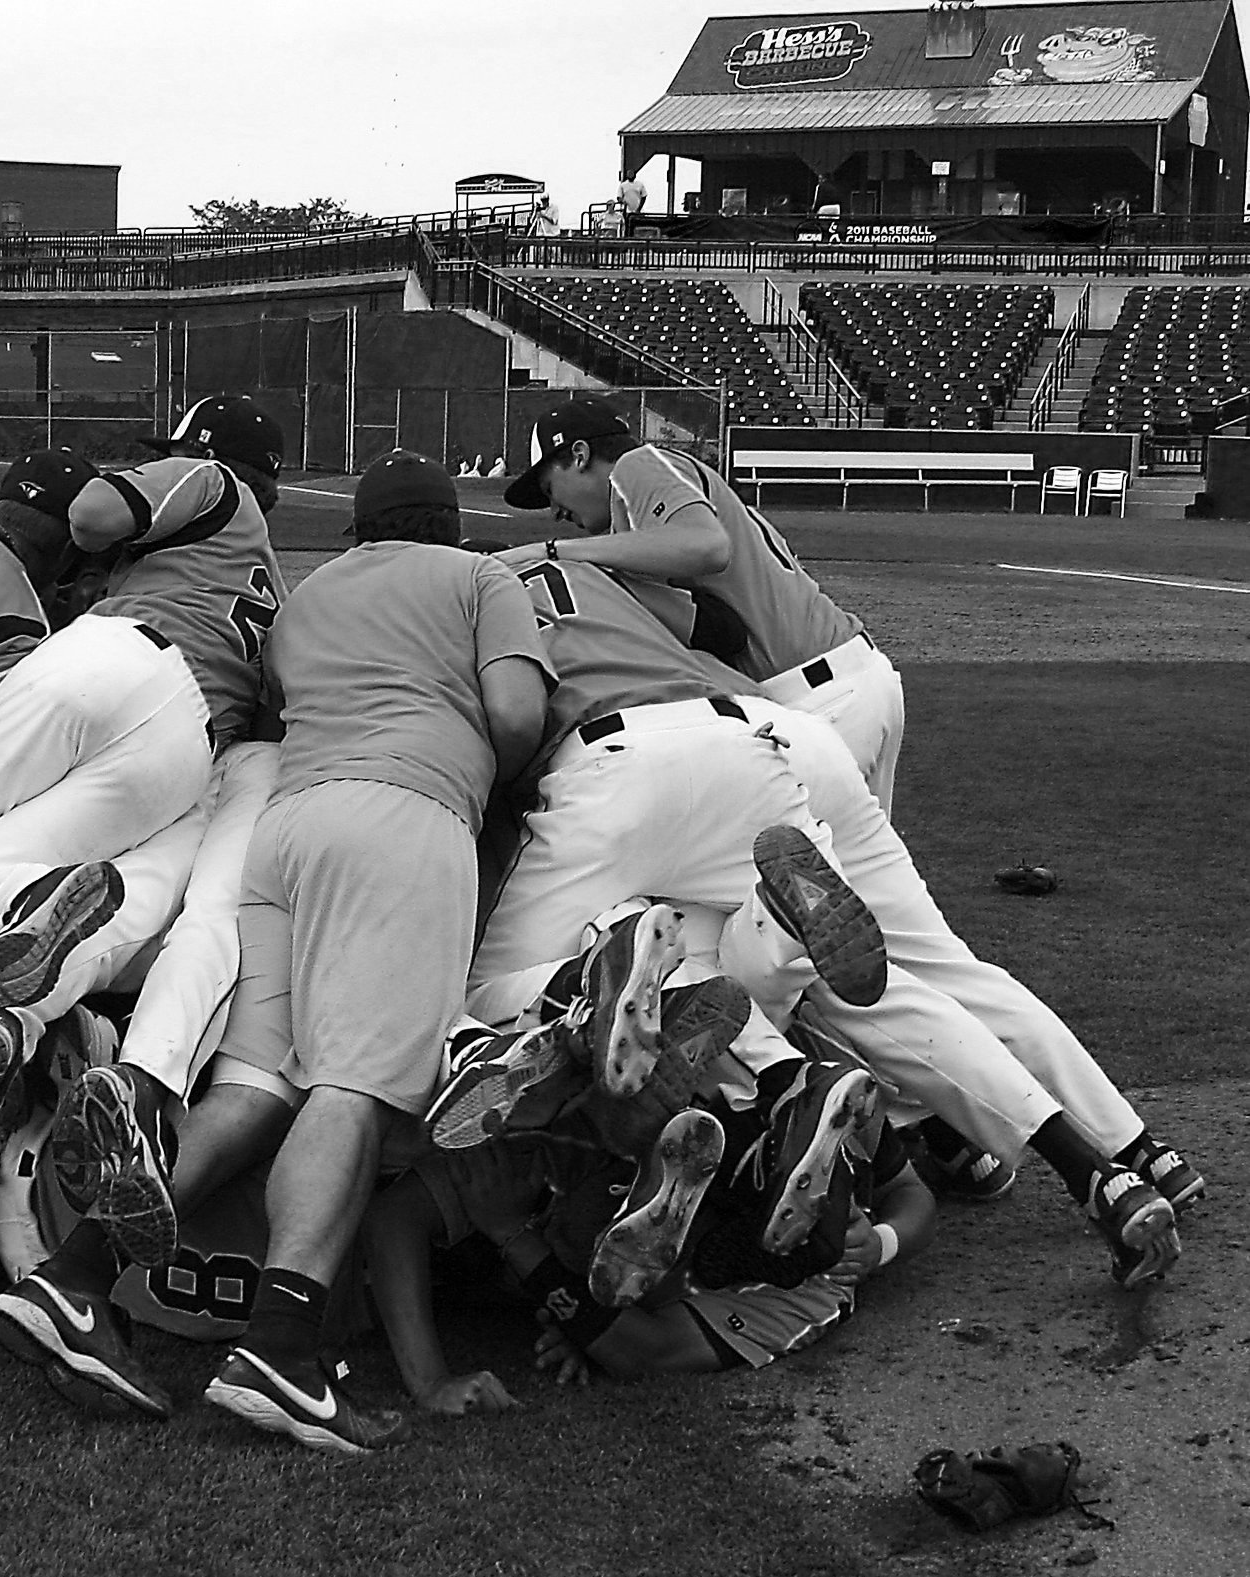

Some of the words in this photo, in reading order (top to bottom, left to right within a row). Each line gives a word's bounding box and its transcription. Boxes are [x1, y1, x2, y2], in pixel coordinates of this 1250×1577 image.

[760, 26, 844, 50] Hess's
[741, 40, 854, 67] BARBECUE
[846, 226, 870, 235] 2011
[872, 226, 932, 235] BASEBALL
[845, 235, 937, 243] CHAMPIONSHIP
